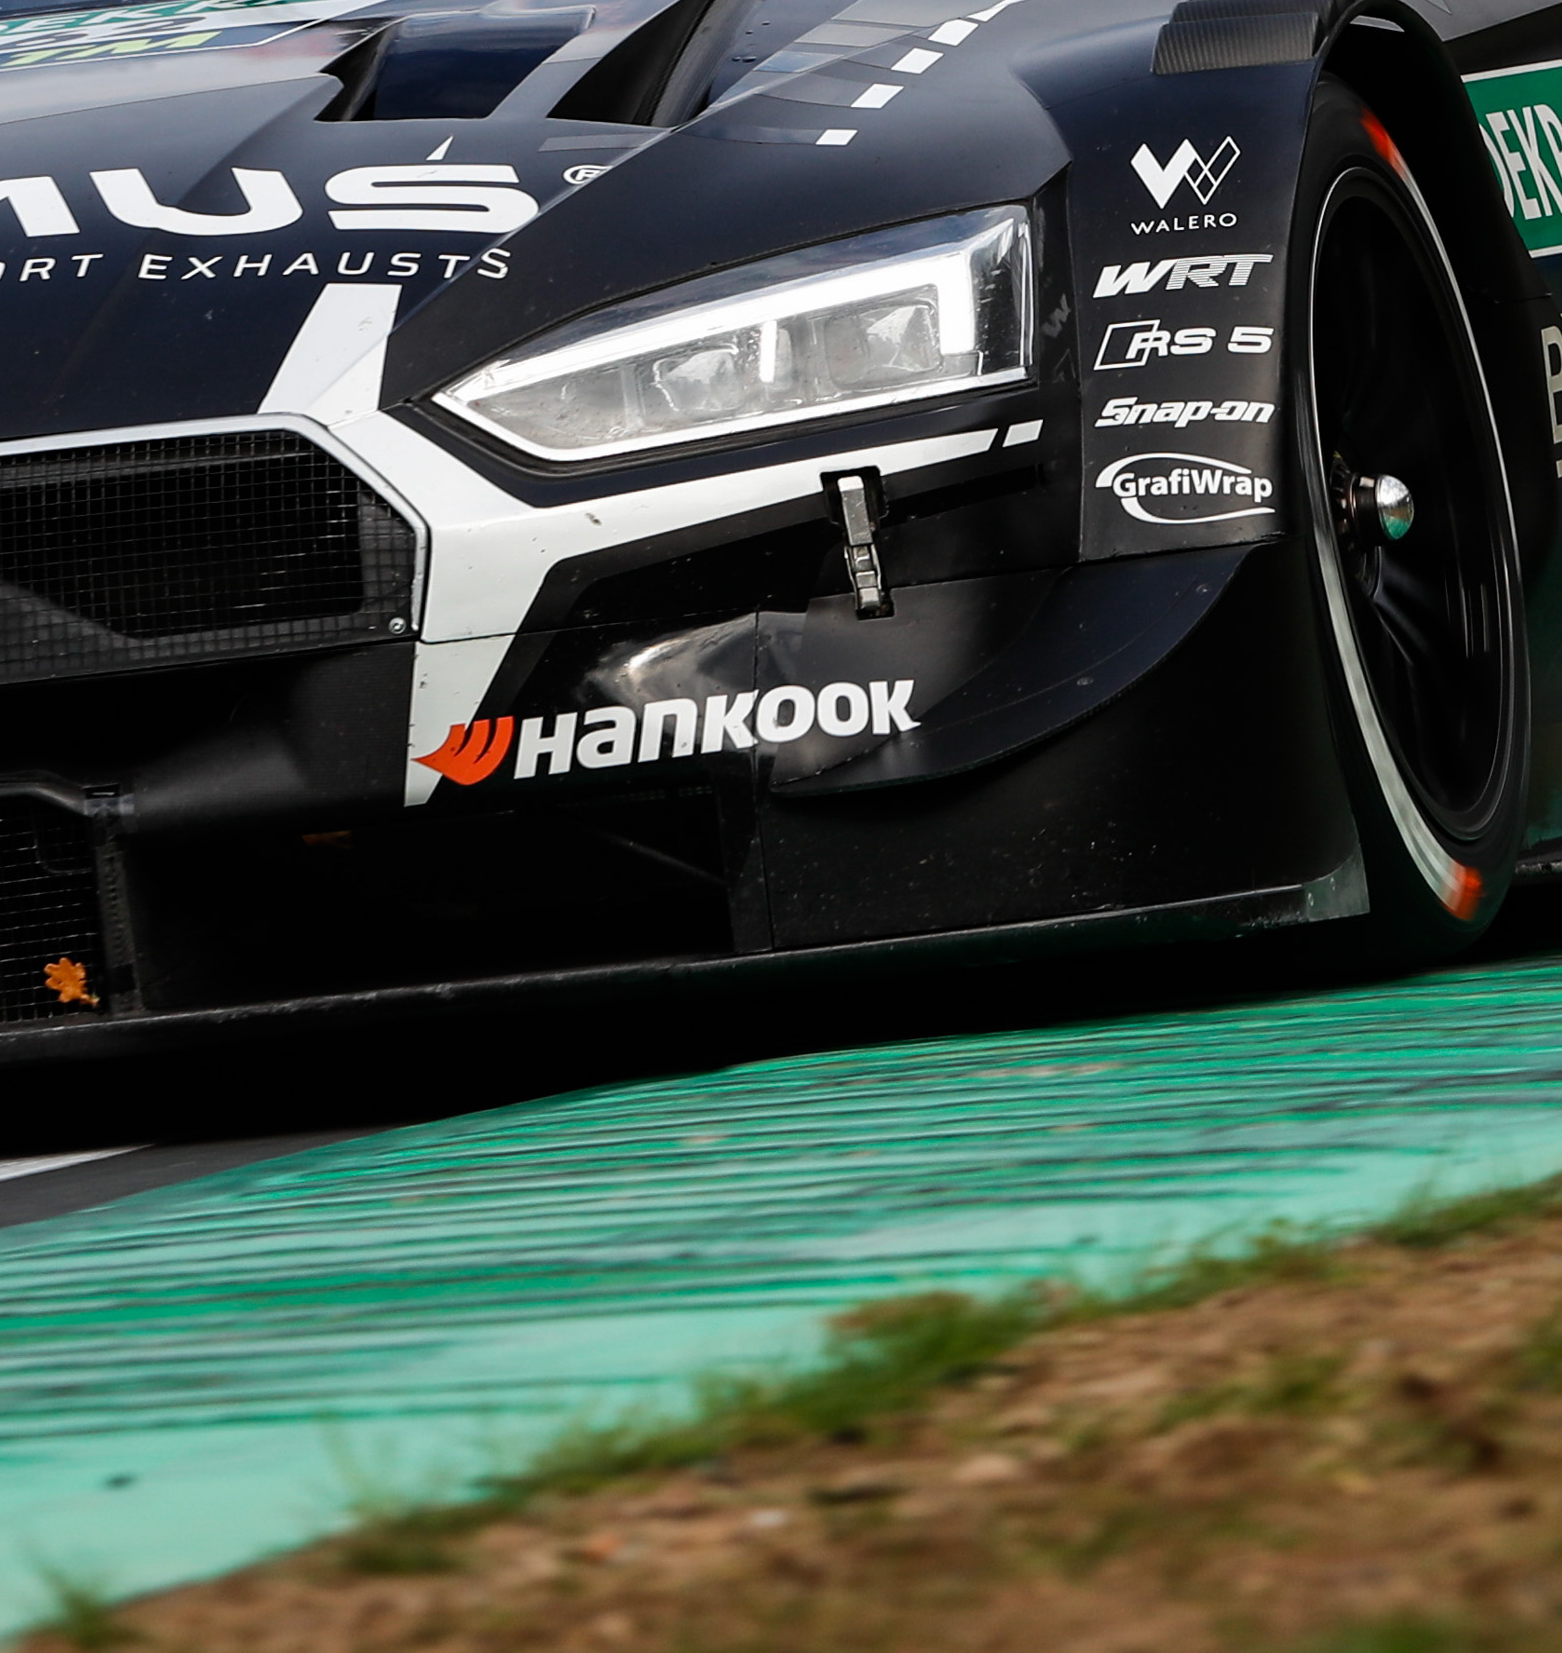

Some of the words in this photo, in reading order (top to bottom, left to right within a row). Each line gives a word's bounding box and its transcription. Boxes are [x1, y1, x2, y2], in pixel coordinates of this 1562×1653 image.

[1131, 212, 1238, 235] WALERO
[137, 247, 513, 283] EXHAUSTS
[1093, 254, 1274, 298] WRT
[1125, 326, 1217, 360] RS
[1227, 325, 1275, 354] 5
[1094, 397, 1275, 428] Snap-on
[1112, 467, 1274, 503] GrafiWrap
